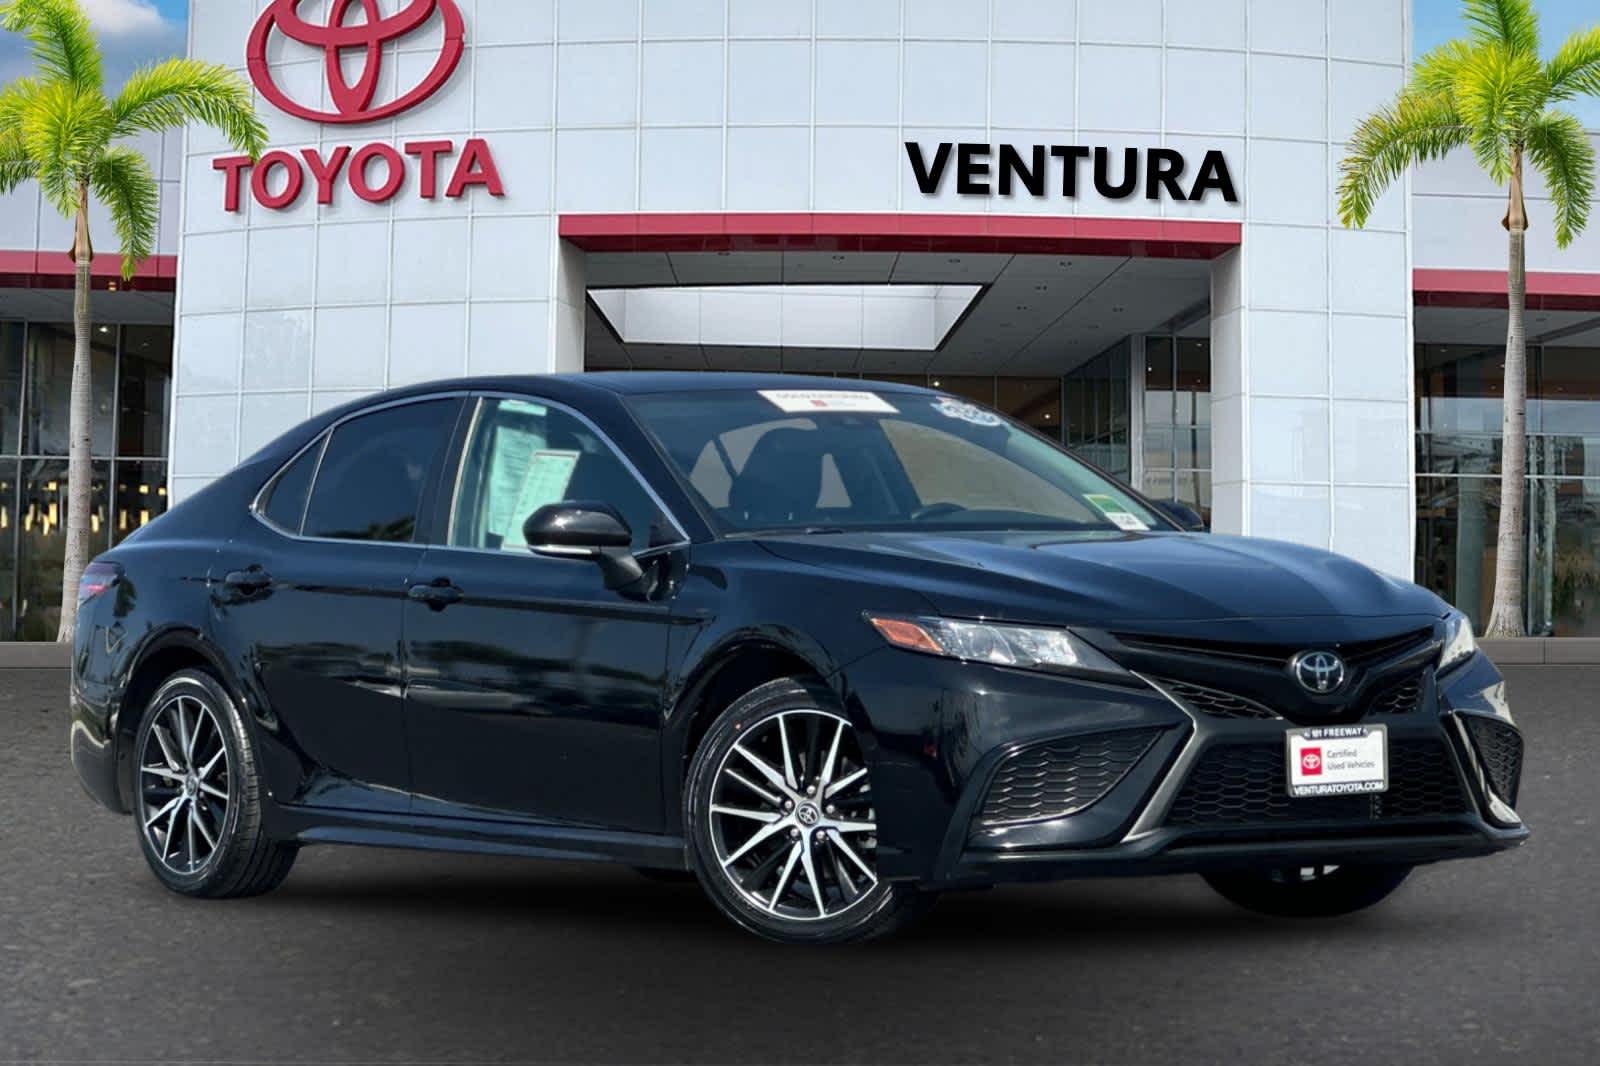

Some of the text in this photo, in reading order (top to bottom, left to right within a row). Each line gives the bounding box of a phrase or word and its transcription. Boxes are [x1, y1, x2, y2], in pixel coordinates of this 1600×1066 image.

[212, 138, 506, 213] TOYOTA
[904, 141, 1239, 203] VENTURA
[1323, 727, 1362, 737] FREEWAY
[1327, 749, 1358, 759] Certified
[1327, 760, 1376, 770] Used Vehicles
[1295, 781, 1384, 796] VENTURATOYOTA.COM
